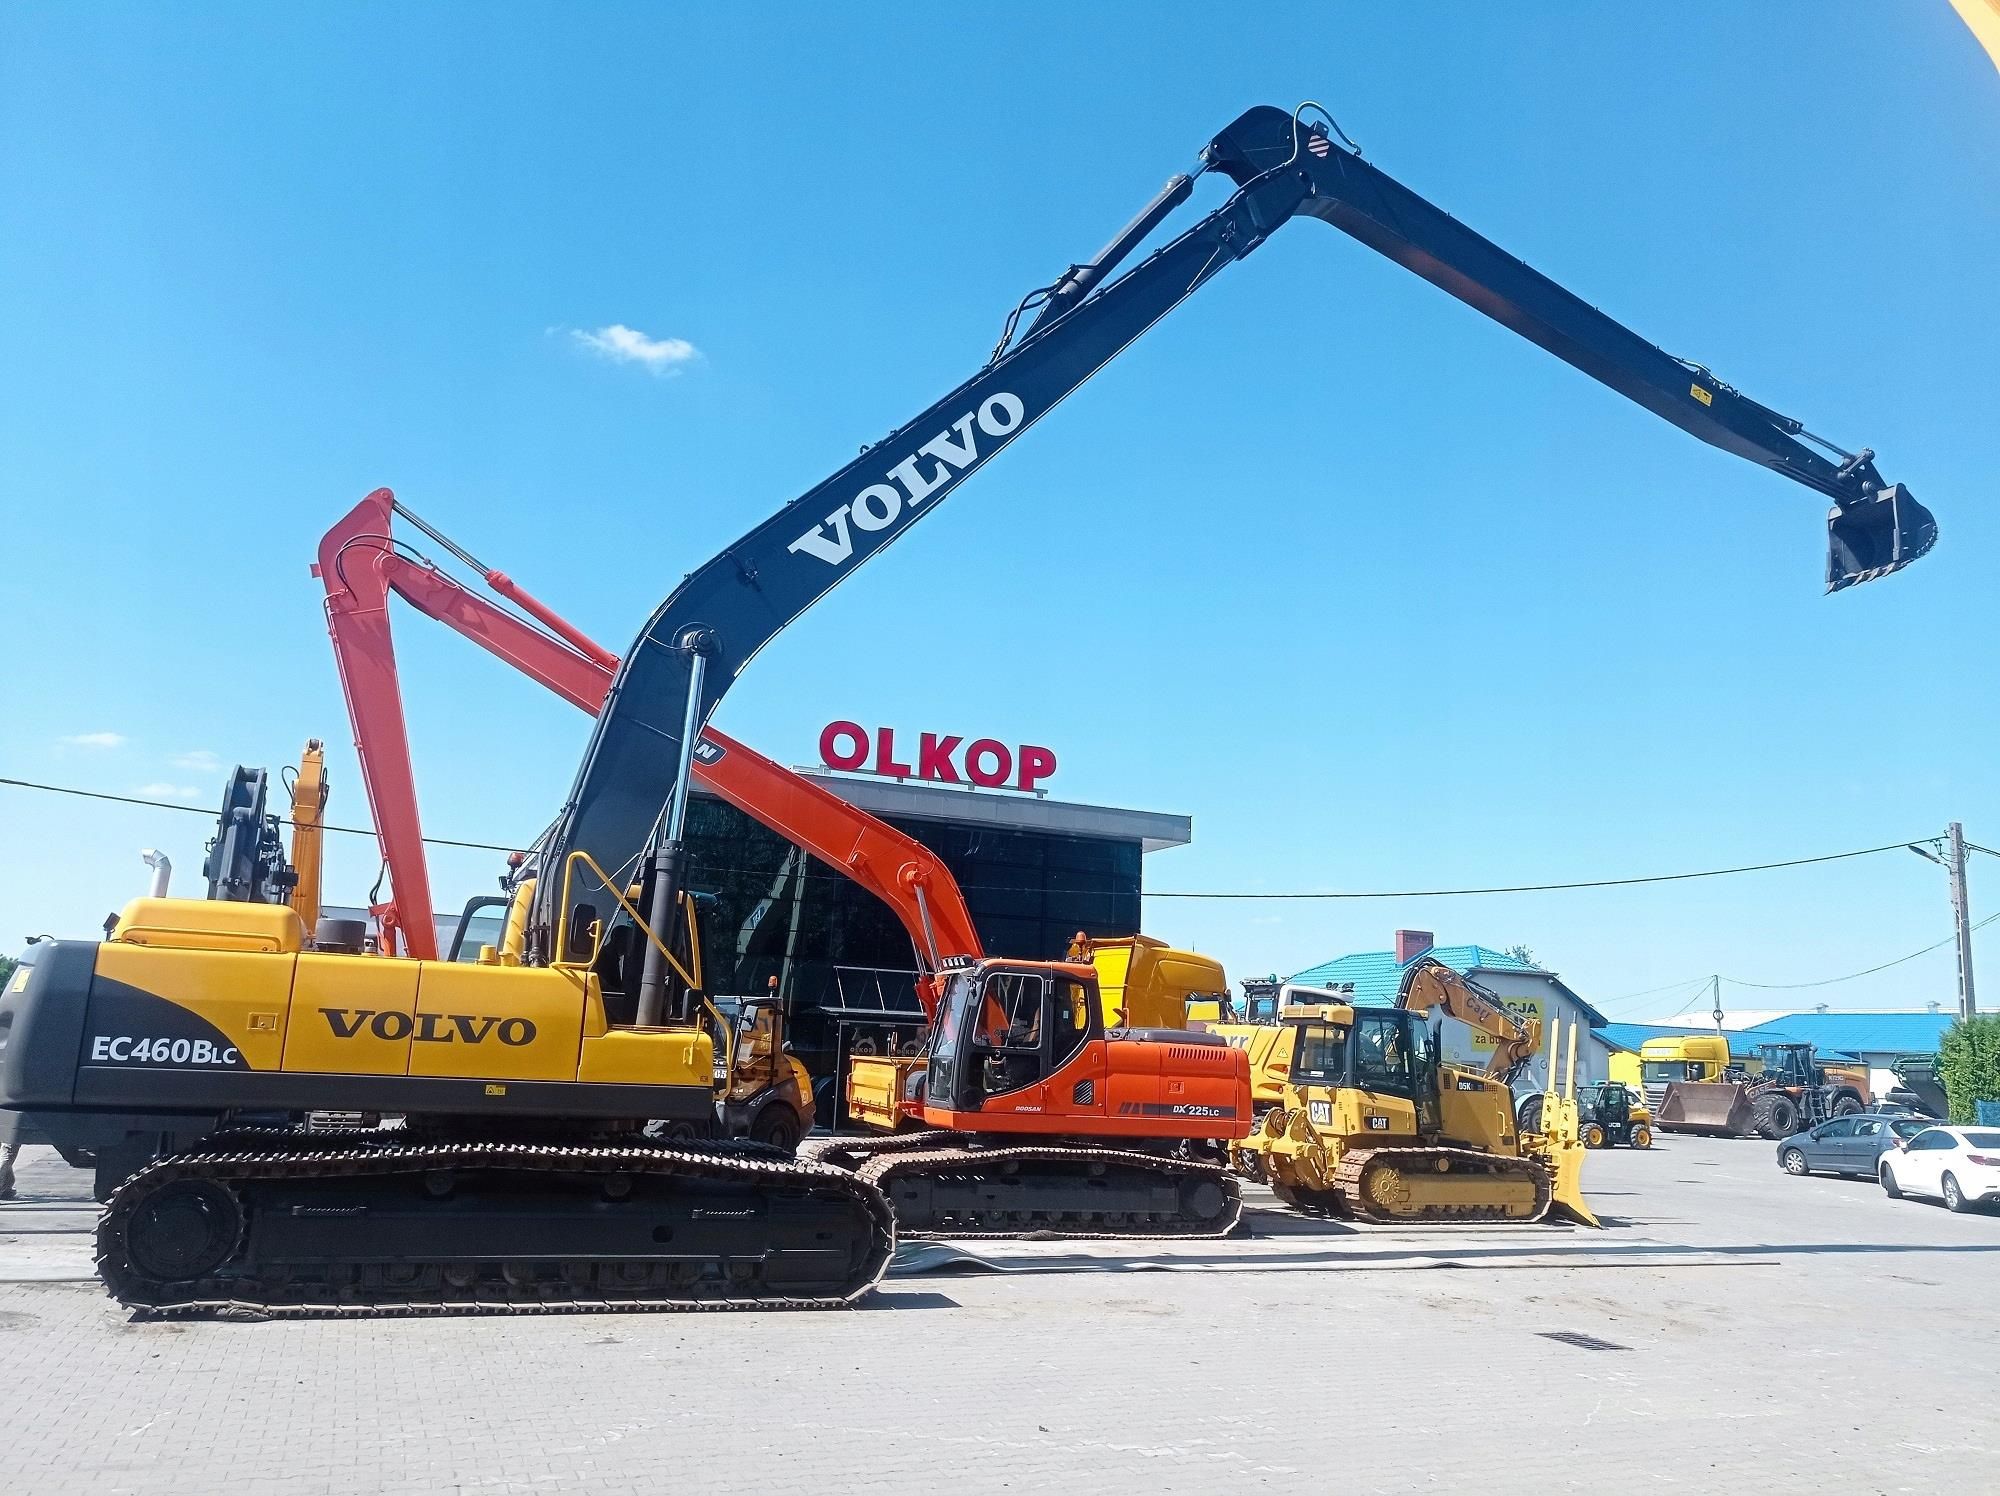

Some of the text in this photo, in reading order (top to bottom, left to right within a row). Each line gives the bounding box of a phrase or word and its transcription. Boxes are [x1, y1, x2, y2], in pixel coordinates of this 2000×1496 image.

[787, 392, 1025, 566] VOLVO
[819, 721, 1057, 792] OLKOP
[318, 1007, 537, 1047] VOLVO
[92, 1036, 238, 1064] EC460BLC
[1475, 1035, 1486, 1044] za
[1458, 1081, 1472, 1091] D5K
[1749, 1085, 1770, 1099] CASE
[1311, 1102, 1330, 1124] CAT
[1372, 1117, 1387, 1129] CAT
